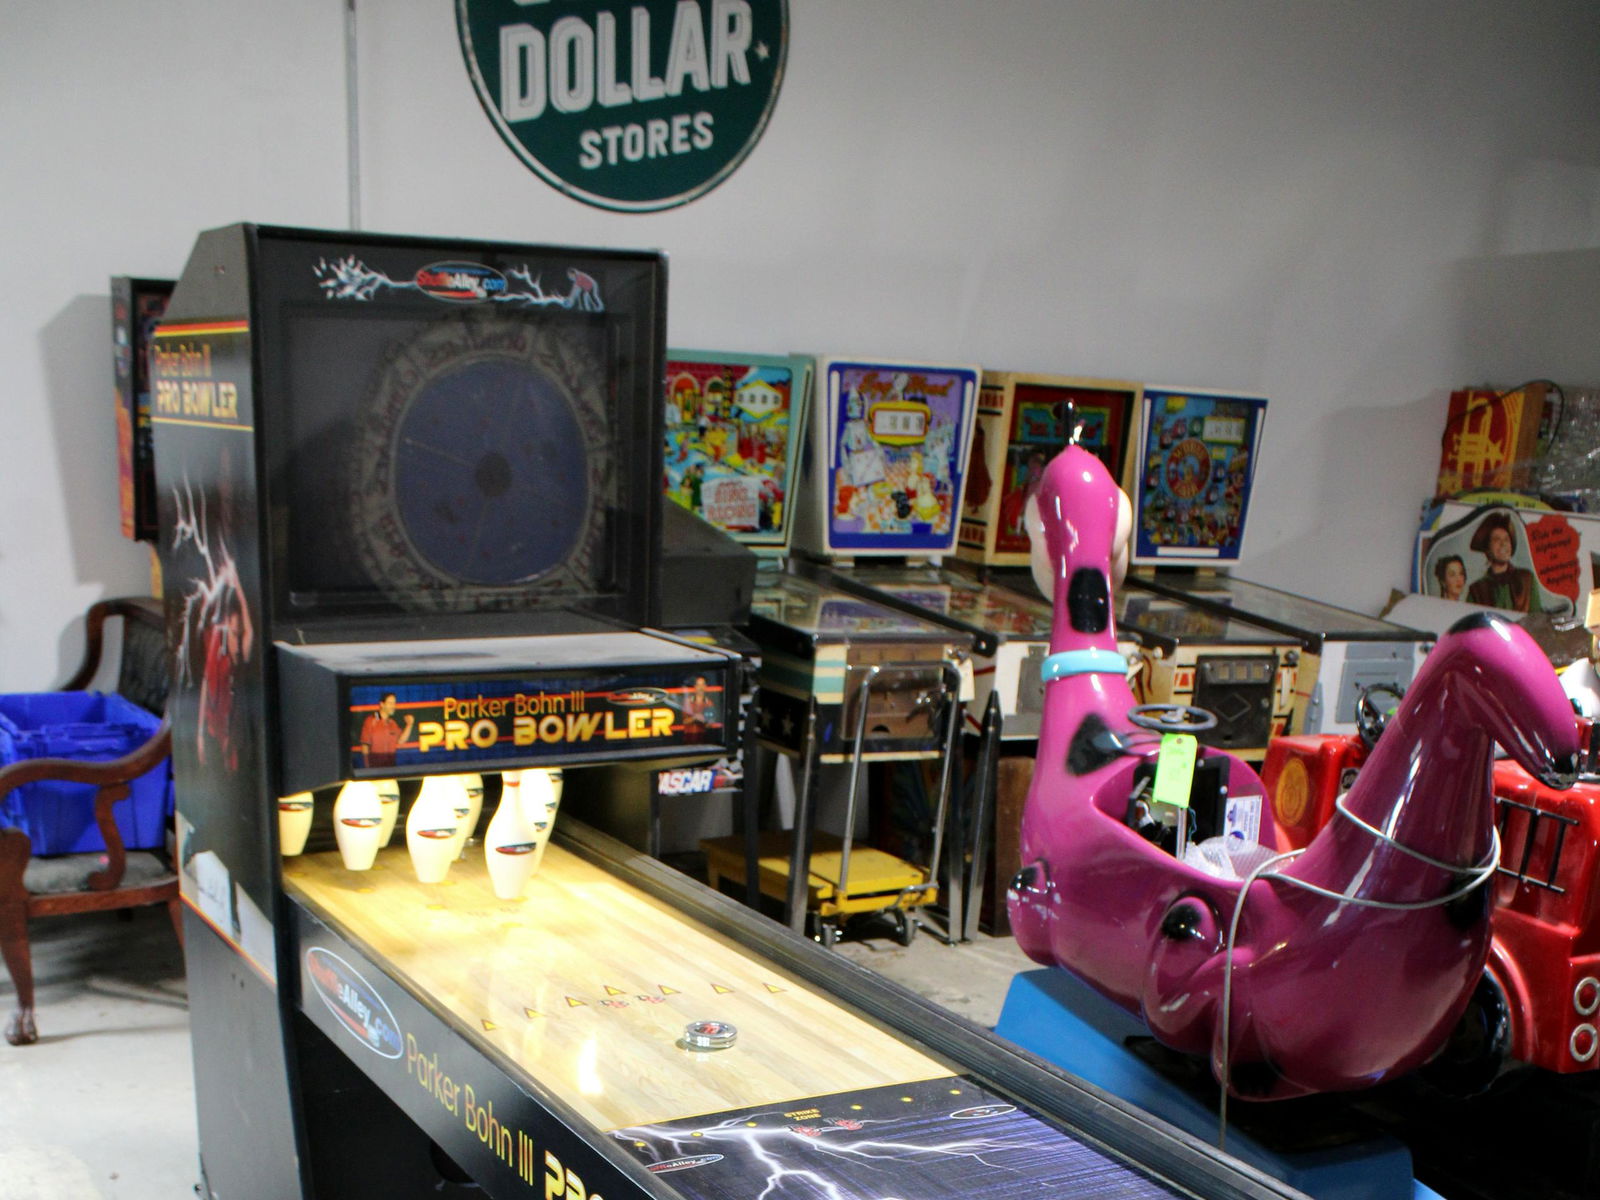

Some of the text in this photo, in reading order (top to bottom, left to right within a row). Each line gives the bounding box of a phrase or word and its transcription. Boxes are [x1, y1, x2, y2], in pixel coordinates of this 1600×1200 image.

[501, 0, 752, 122] DOLLAR
[578, 112, 714, 170] STORES
[156, 379, 239, 419] PRO BOWLER
[443, 695, 507, 720] Parker
[513, 693, 565, 717] Bohn
[570, 690, 585, 713] III
[418, 707, 676, 752] PRO BOWLER
[406, 1032, 534, 1186] Parker Bohn III
[784, 1107, 820, 1118] STRIKE
[793, 1113, 822, 1122] ZONE
